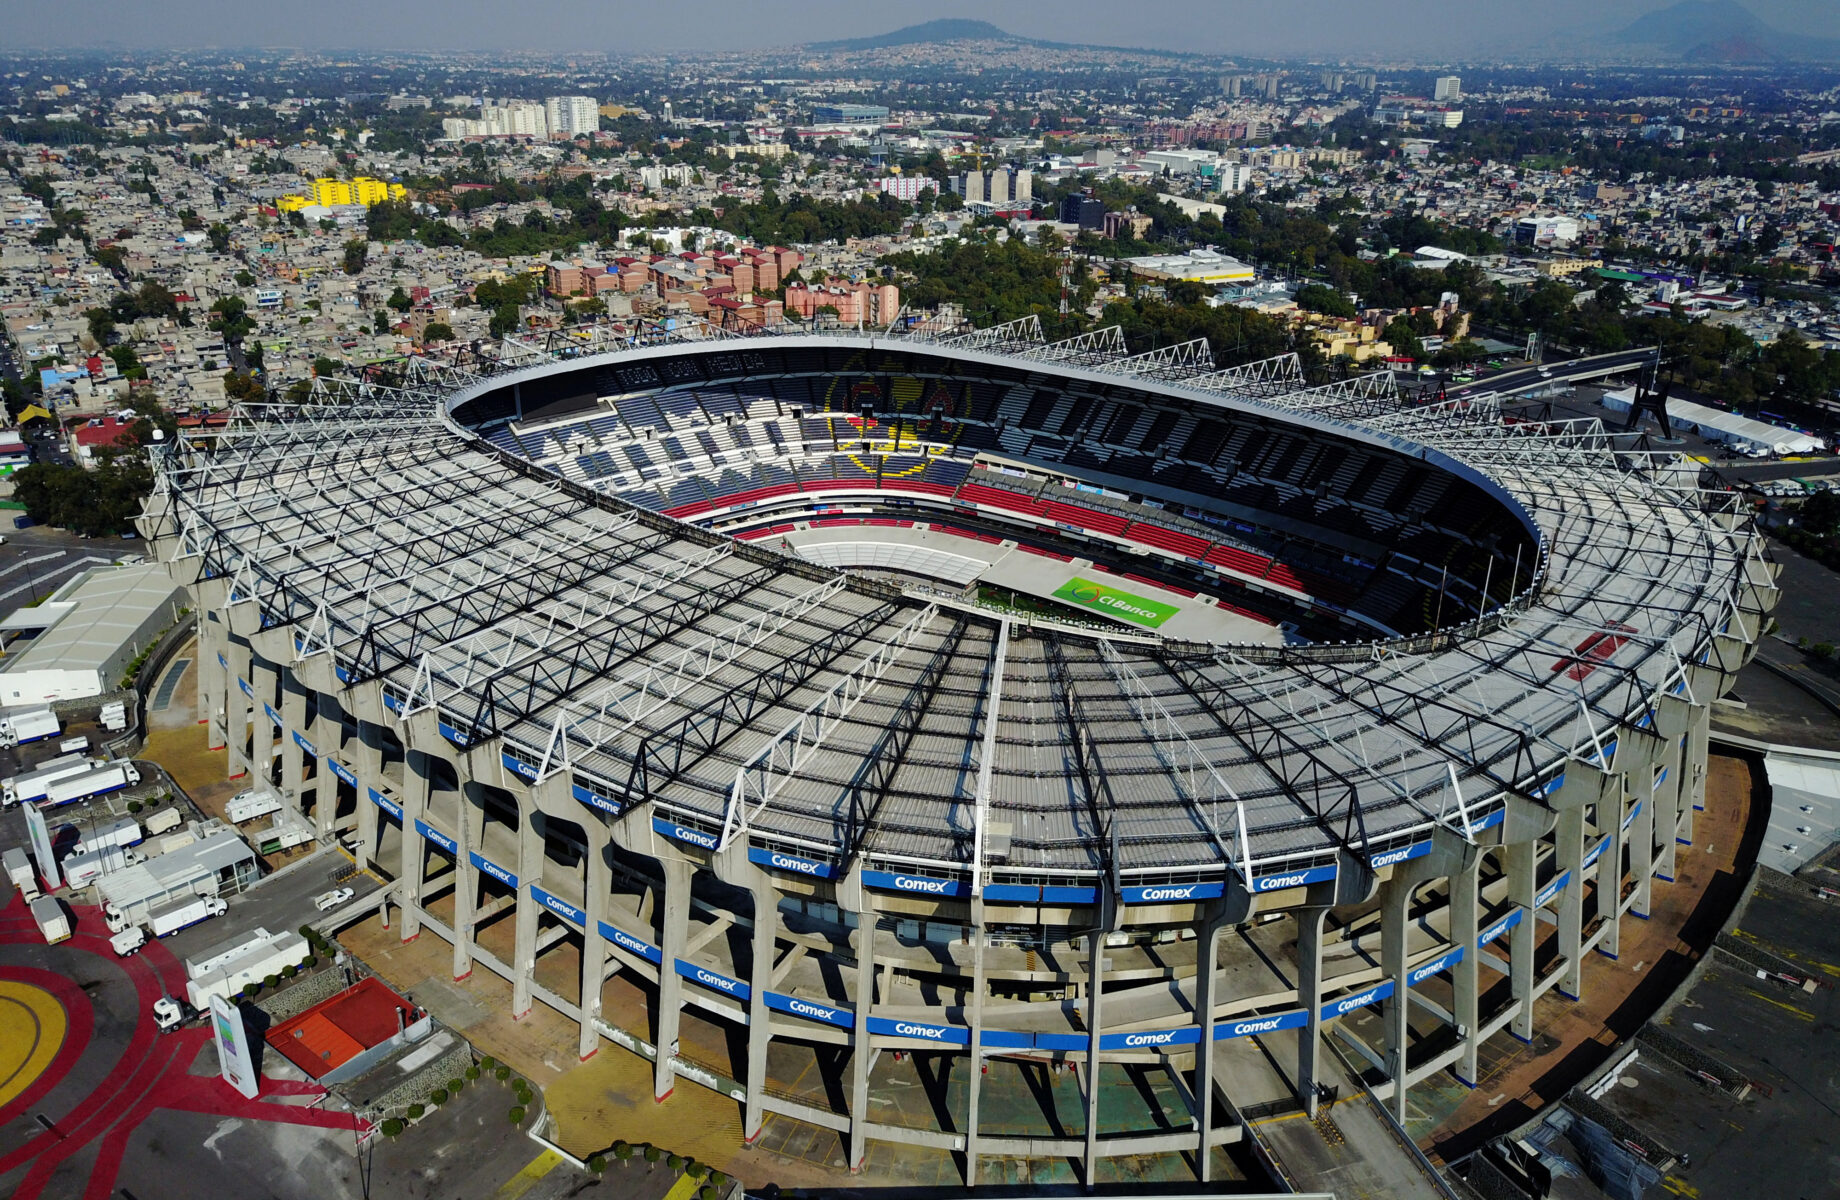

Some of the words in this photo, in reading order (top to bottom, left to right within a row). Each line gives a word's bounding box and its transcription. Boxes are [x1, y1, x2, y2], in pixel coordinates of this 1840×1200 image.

[379, 797, 400, 816] Comex
[427, 829, 451, 849] Comex
[675, 827, 717, 849] Comex
[771, 854, 820, 875] Comex
[1371, 846, 1413, 868] Comex
[483, 861, 510, 883] Comex
[1259, 871, 1310, 890] Comex
[895, 876, 949, 893] Comex
[1141, 885, 1197, 900] Comex
[546, 896, 577, 918] Comex
[1482, 918, 1509, 944] Comex
[615, 932, 649, 954] Comex
[1413, 956, 1448, 981] Comex
[697, 970, 737, 991] Comex
[789, 1000, 836, 1020] Comex
[1338, 989, 1377, 1013] Comex
[895, 1023, 947, 1039] Comex
[1234, 1017, 1282, 1035] Comex
[1125, 1030, 1177, 1046] Comex
